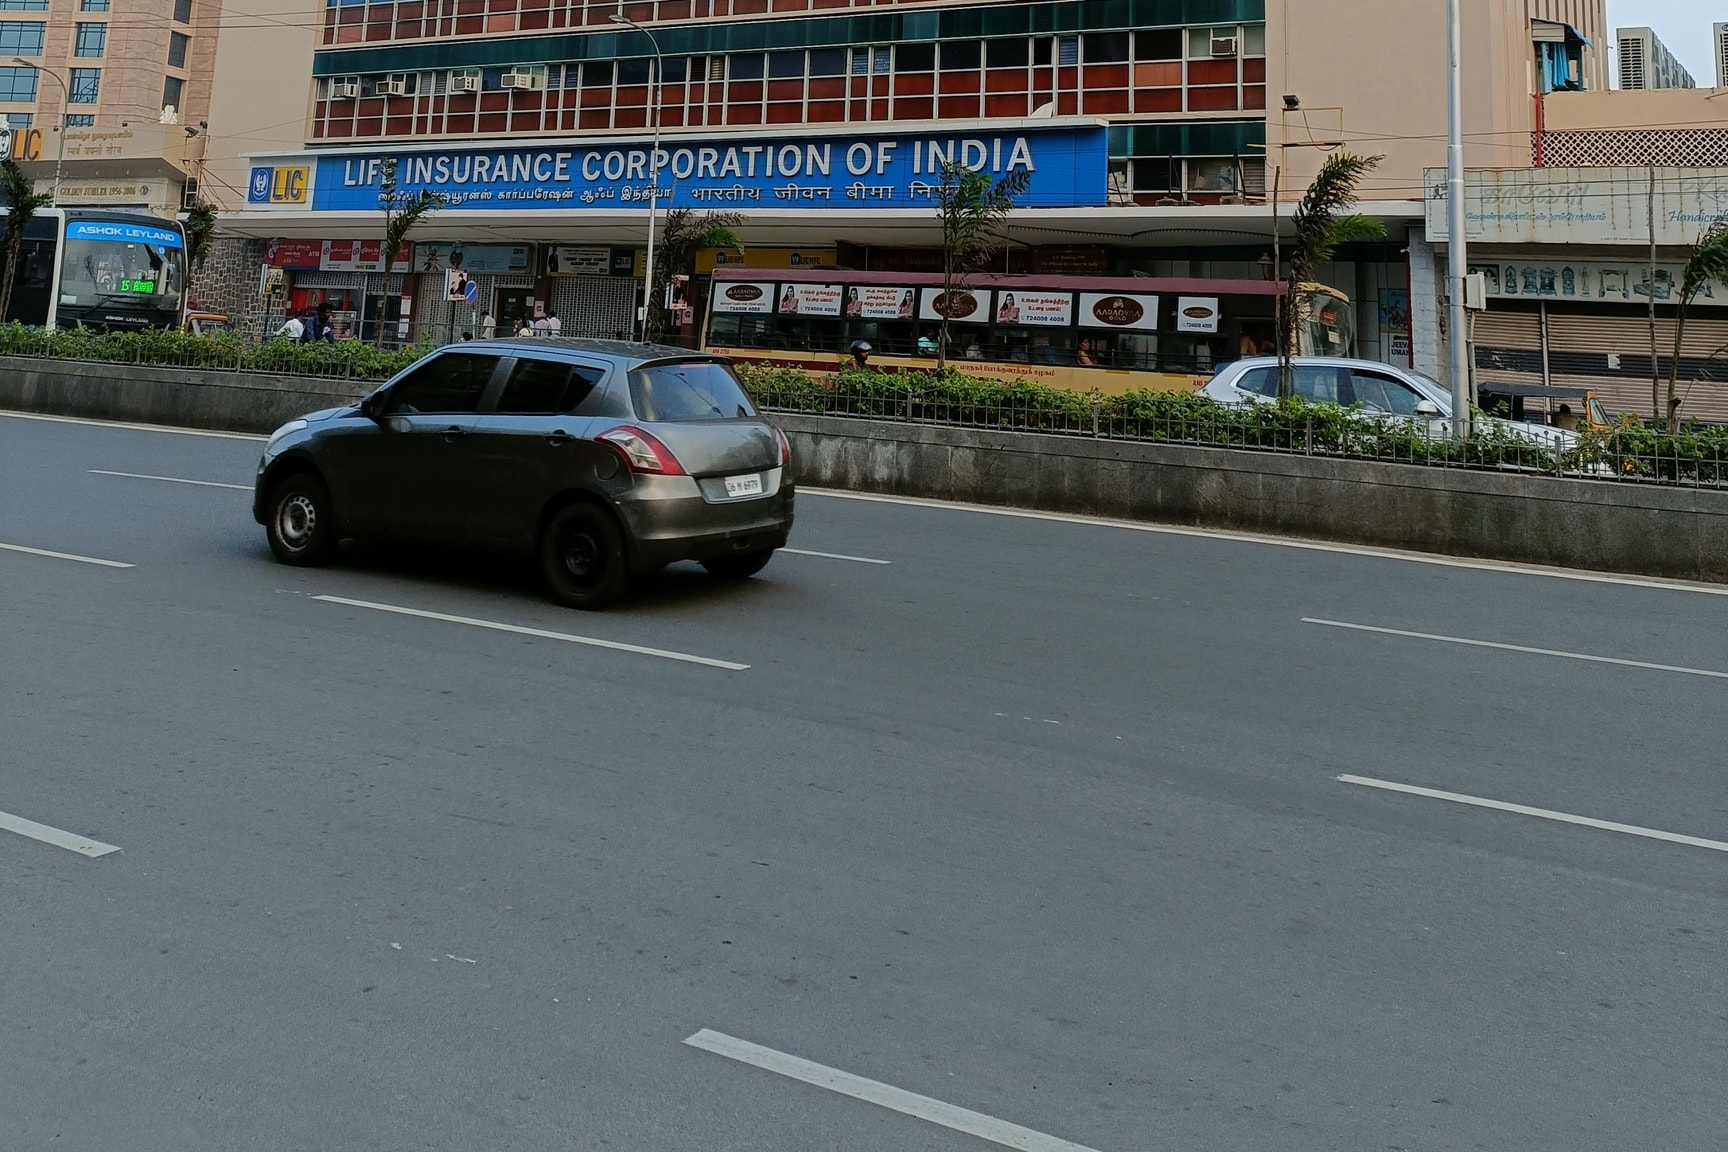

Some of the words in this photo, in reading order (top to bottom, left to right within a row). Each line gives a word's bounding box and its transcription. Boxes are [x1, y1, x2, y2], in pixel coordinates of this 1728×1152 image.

[12, 129, 41, 161] LIC
[405, 152, 572, 184] INSURANCE
[582, 142, 831, 181] CORPORATION
[845, 141, 897, 176] OF
[913, 137, 1035, 174] INDIA
[272, 169, 303, 201] LIC
[497, 187, 575, 202] கார்ப்பரேஷன்
[579, 186, 615, 202] ஆஃப்
[691, 184, 762, 202] भारतीय
[774, 182, 833, 201] जीवन
[845, 181, 895, 200] बीमा
[77, 226, 122, 236] ASHOK
[125, 228, 175, 242] LEYLAND
[120, 280, 130, 291] 15
[1095, 308, 1141, 318] AARADYAA
